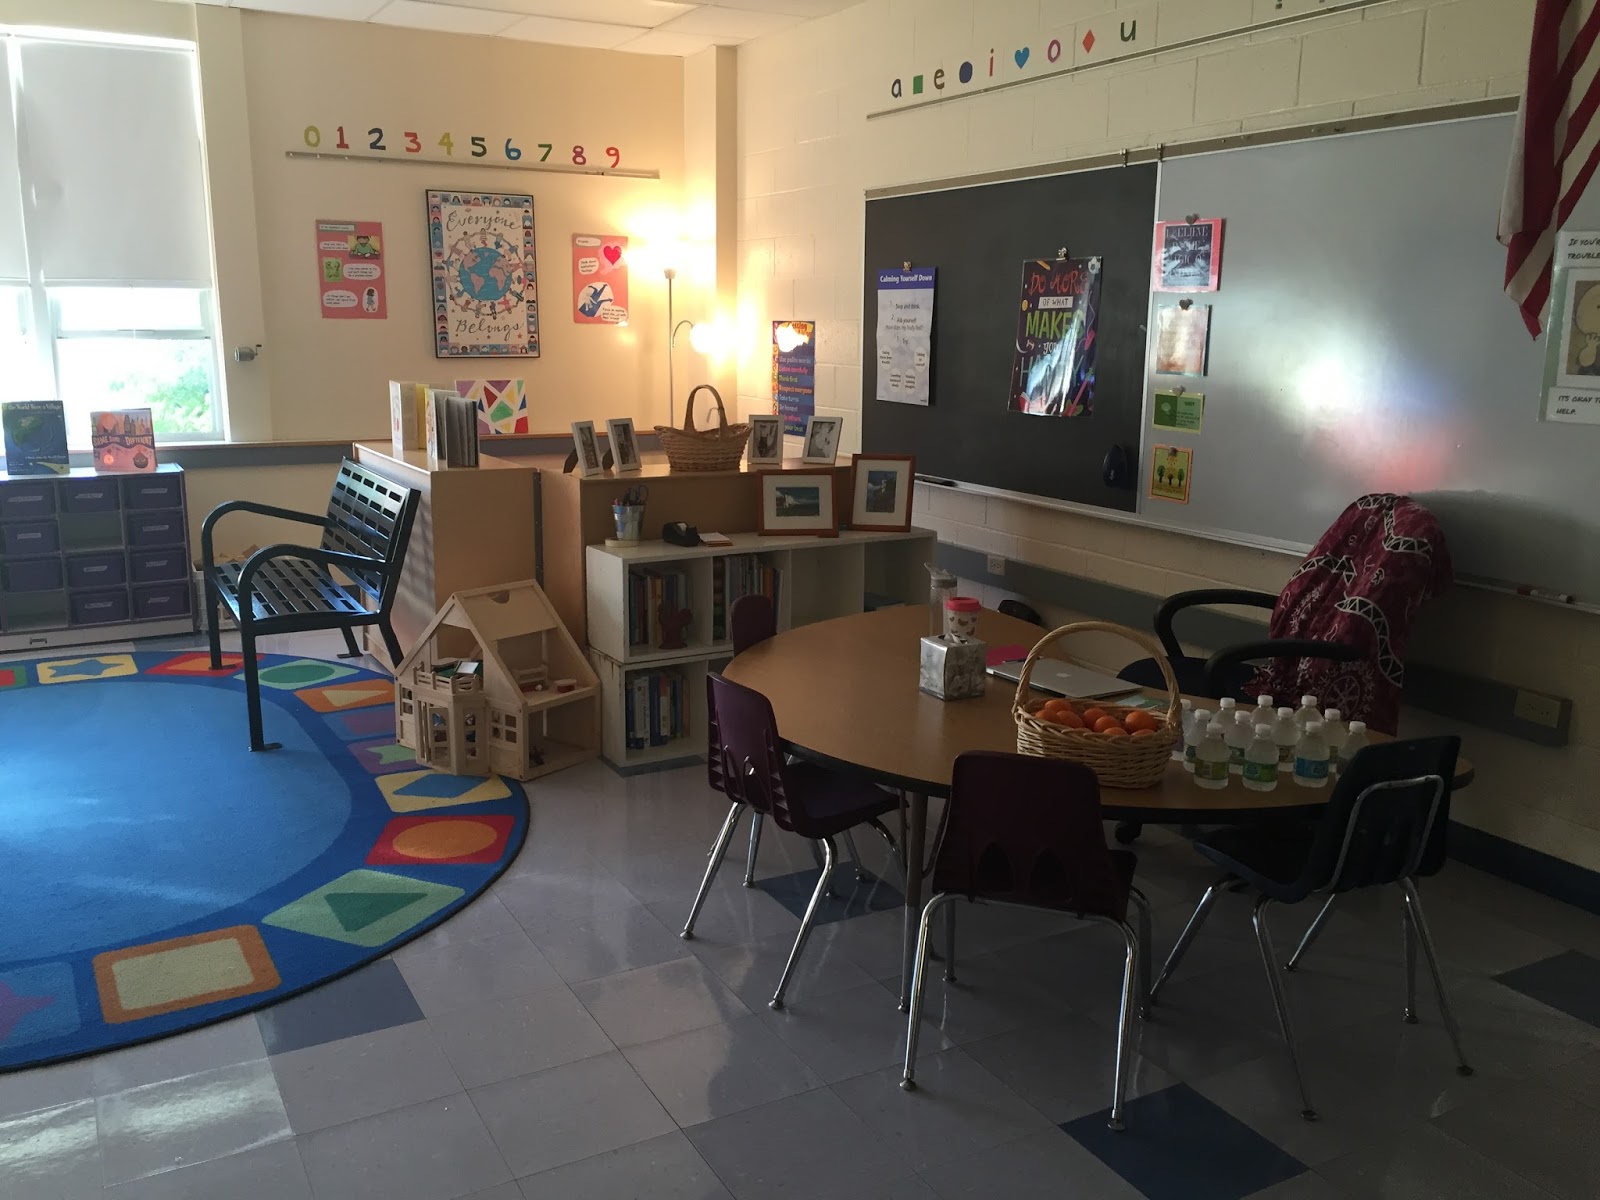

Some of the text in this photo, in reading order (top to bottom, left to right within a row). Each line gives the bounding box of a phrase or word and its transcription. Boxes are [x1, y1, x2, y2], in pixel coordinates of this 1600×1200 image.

[891, 20, 1136, 98] a e i o u
[304, 125, 620, 168] 0 1 2 3 4 5 6 7 8 9
[446, 210, 521, 231] Everyone
[1568, 238, 1578, 246] IF
[880, 274, 932, 284] Calming Yourself Down
[1029, 270, 1088, 296] DO MORE
[1042, 298, 1069, 306] OF WHAT
[456, 318, 524, 341] Belongs
[1025, 309, 1085, 340] MAKES
